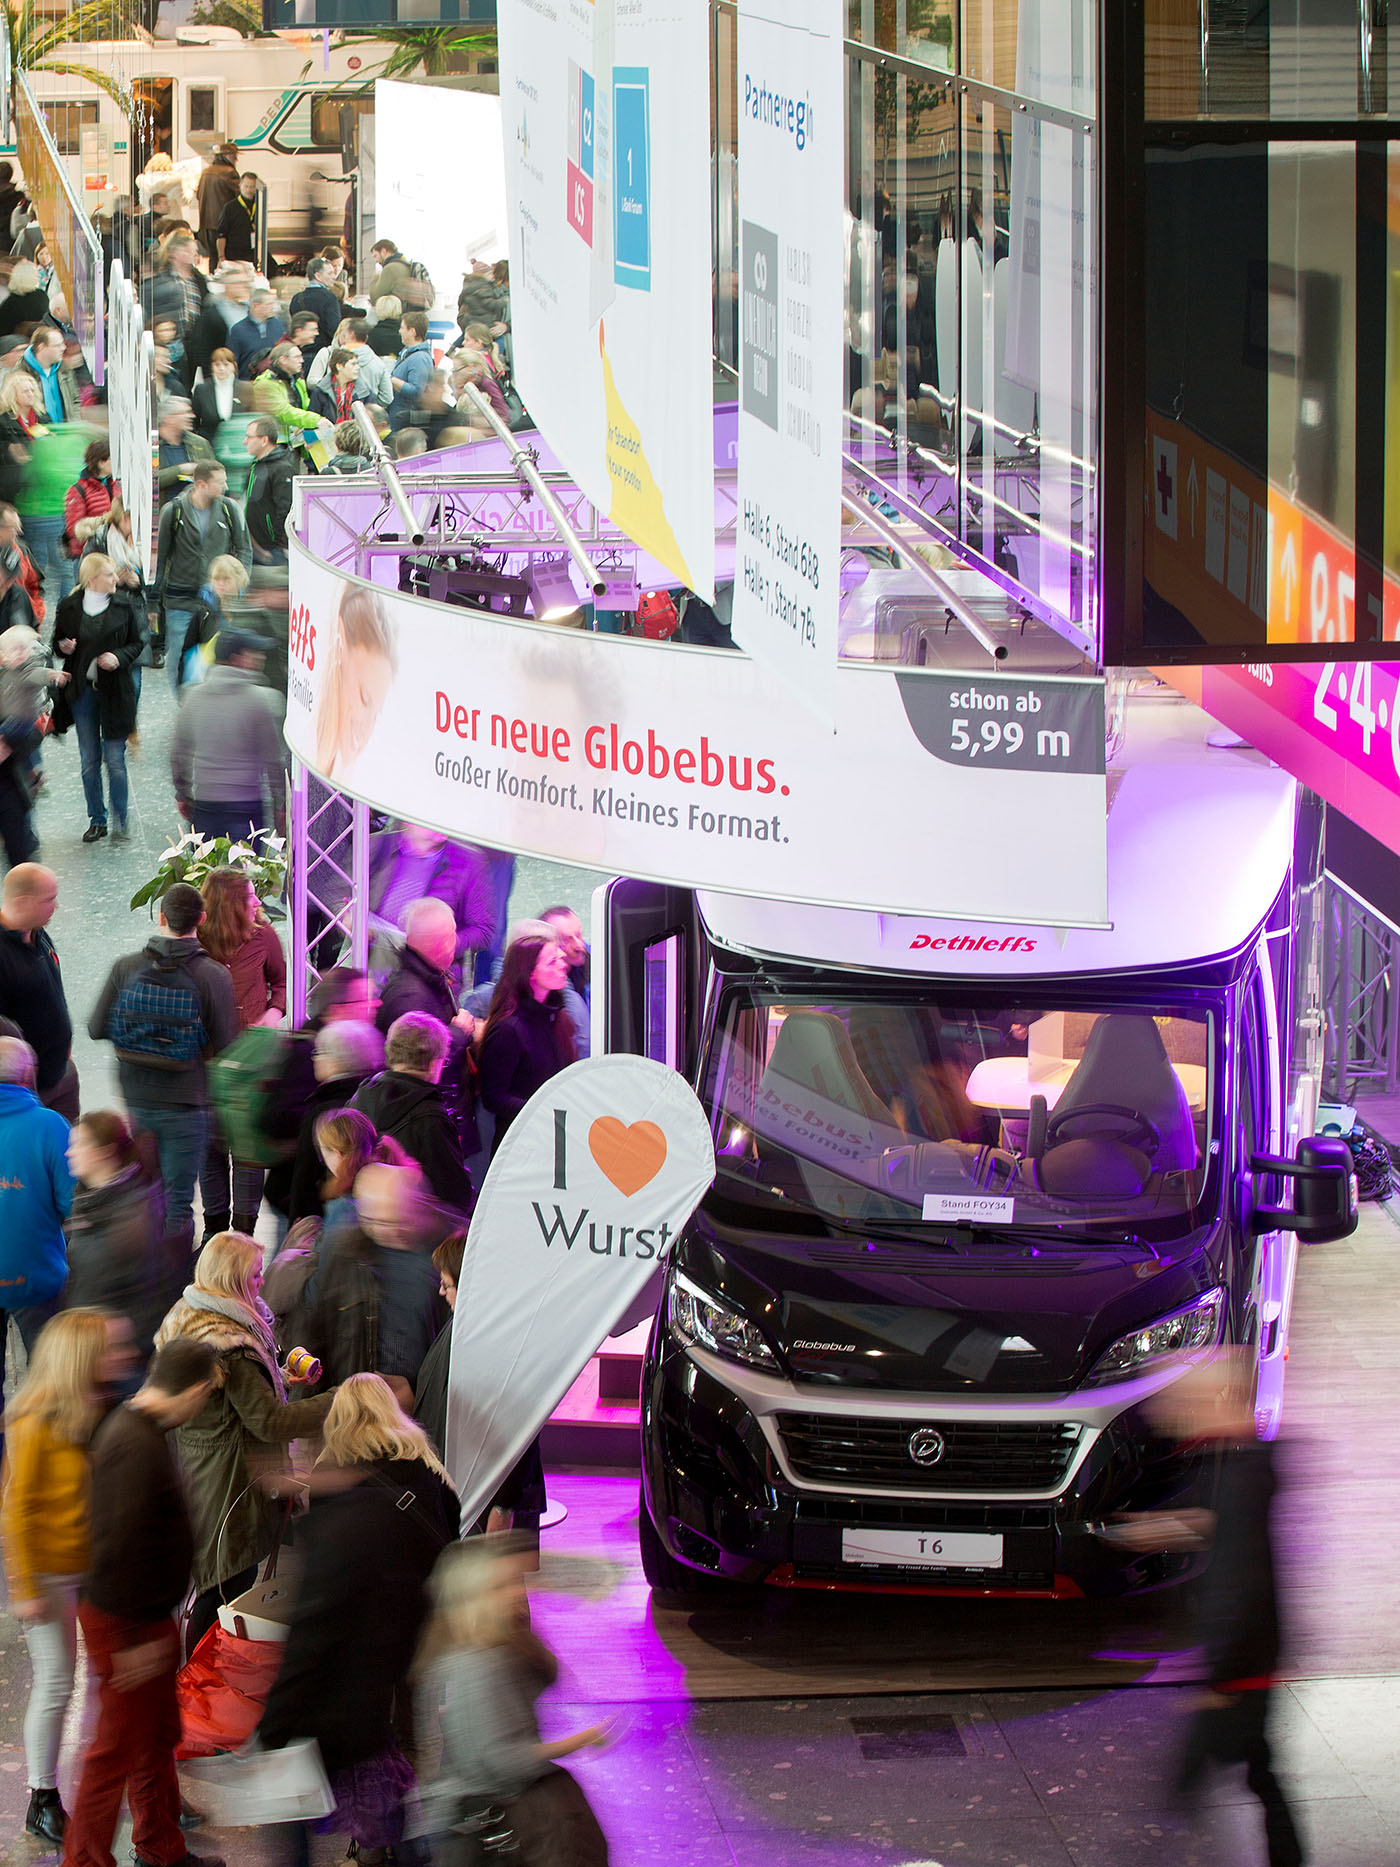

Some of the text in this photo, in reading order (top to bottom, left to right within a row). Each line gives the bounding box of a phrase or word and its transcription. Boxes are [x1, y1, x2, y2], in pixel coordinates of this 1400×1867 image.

[744, 498, 764, 543] Halle
[776, 523, 799, 571] Stand
[744, 555, 764, 601] Halle
[775, 581, 798, 630] Stand
[950, 688, 1042, 713] schon ab
[435, 691, 791, 797] Der neue Globebus.
[950, 718, 1071, 758] 5,99 m
[435, 751, 790, 845] Großer Komfort. Kleines Format.
[909, 934, 1038, 953] Dethleffs
[553, 1108, 567, 1190] I
[941, 1199, 1006, 1210] Stand FOY34
[531, 1201, 673, 1261] Wurst
[793, 1339, 857, 1352] Globebus
[918, 1538, 943, 1554] T 6
